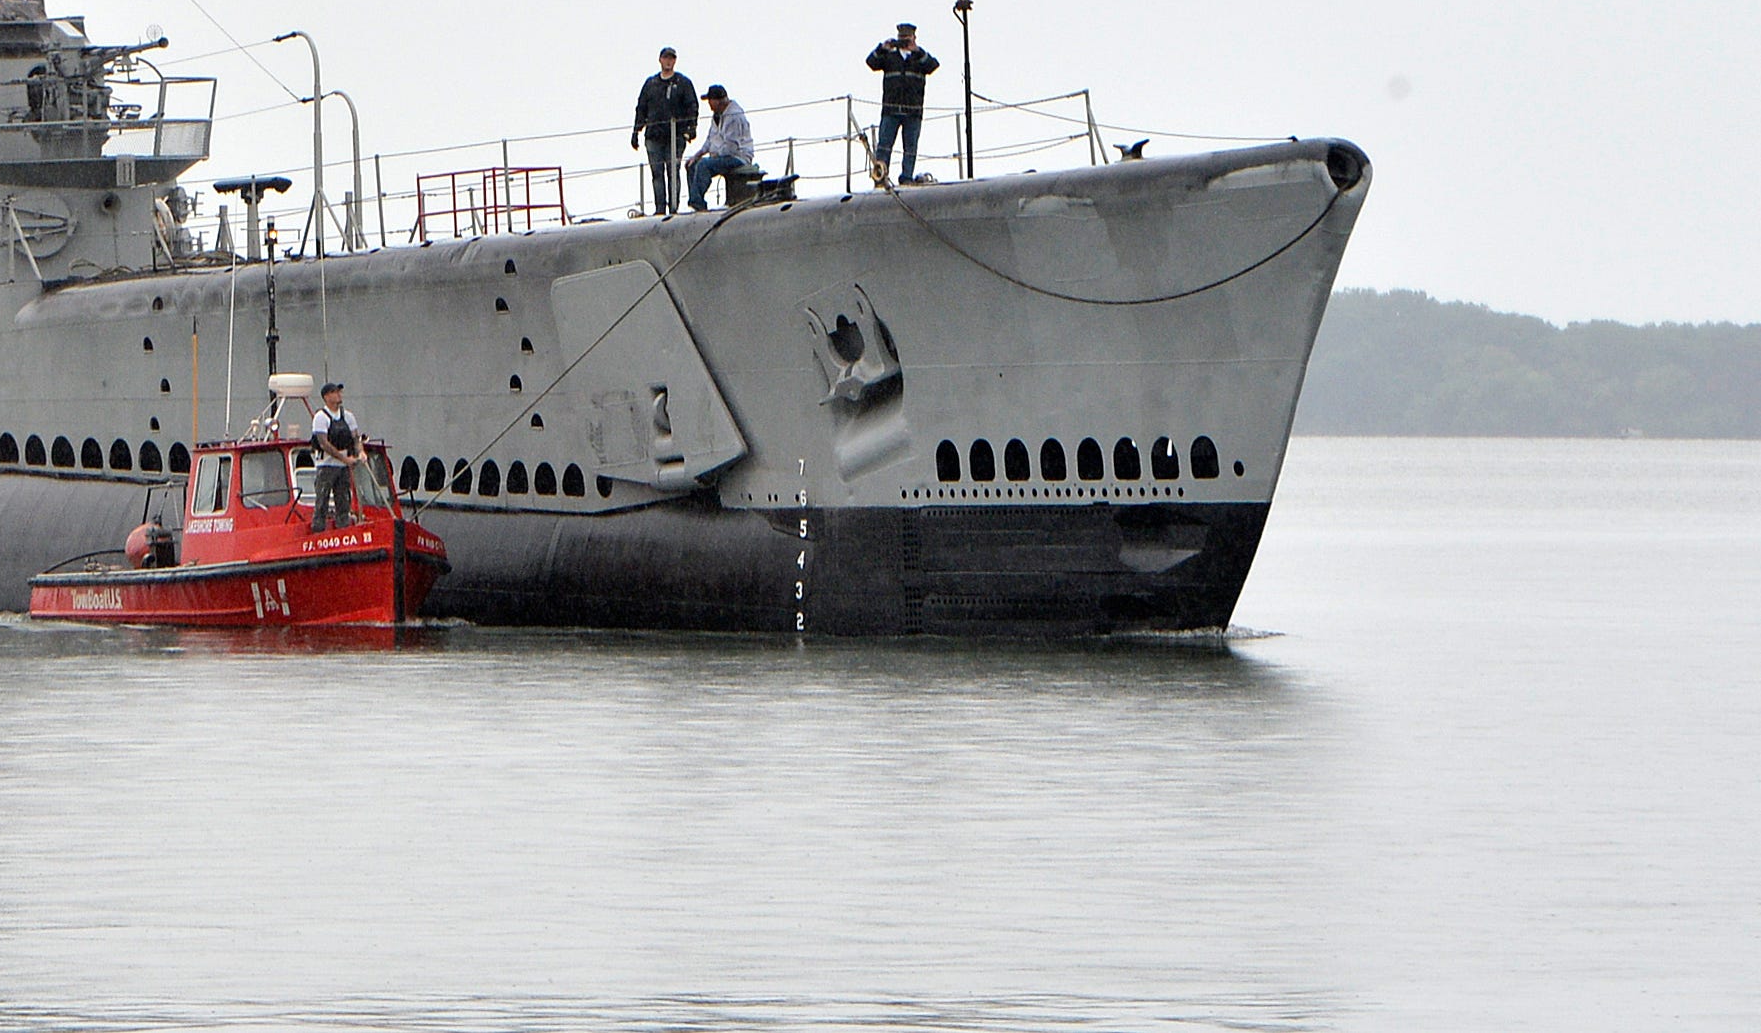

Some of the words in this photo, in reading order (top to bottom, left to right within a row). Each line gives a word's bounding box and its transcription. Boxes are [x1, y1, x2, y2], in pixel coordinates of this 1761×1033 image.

[798, 459, 805, 476] 7
[799, 489, 807, 507] 6
[799, 519, 807, 538] 5
[342, 534, 358, 546] CA
[797, 550, 805, 570] 4
[795, 581, 803, 599] 3
[796, 612, 804, 631] 2
